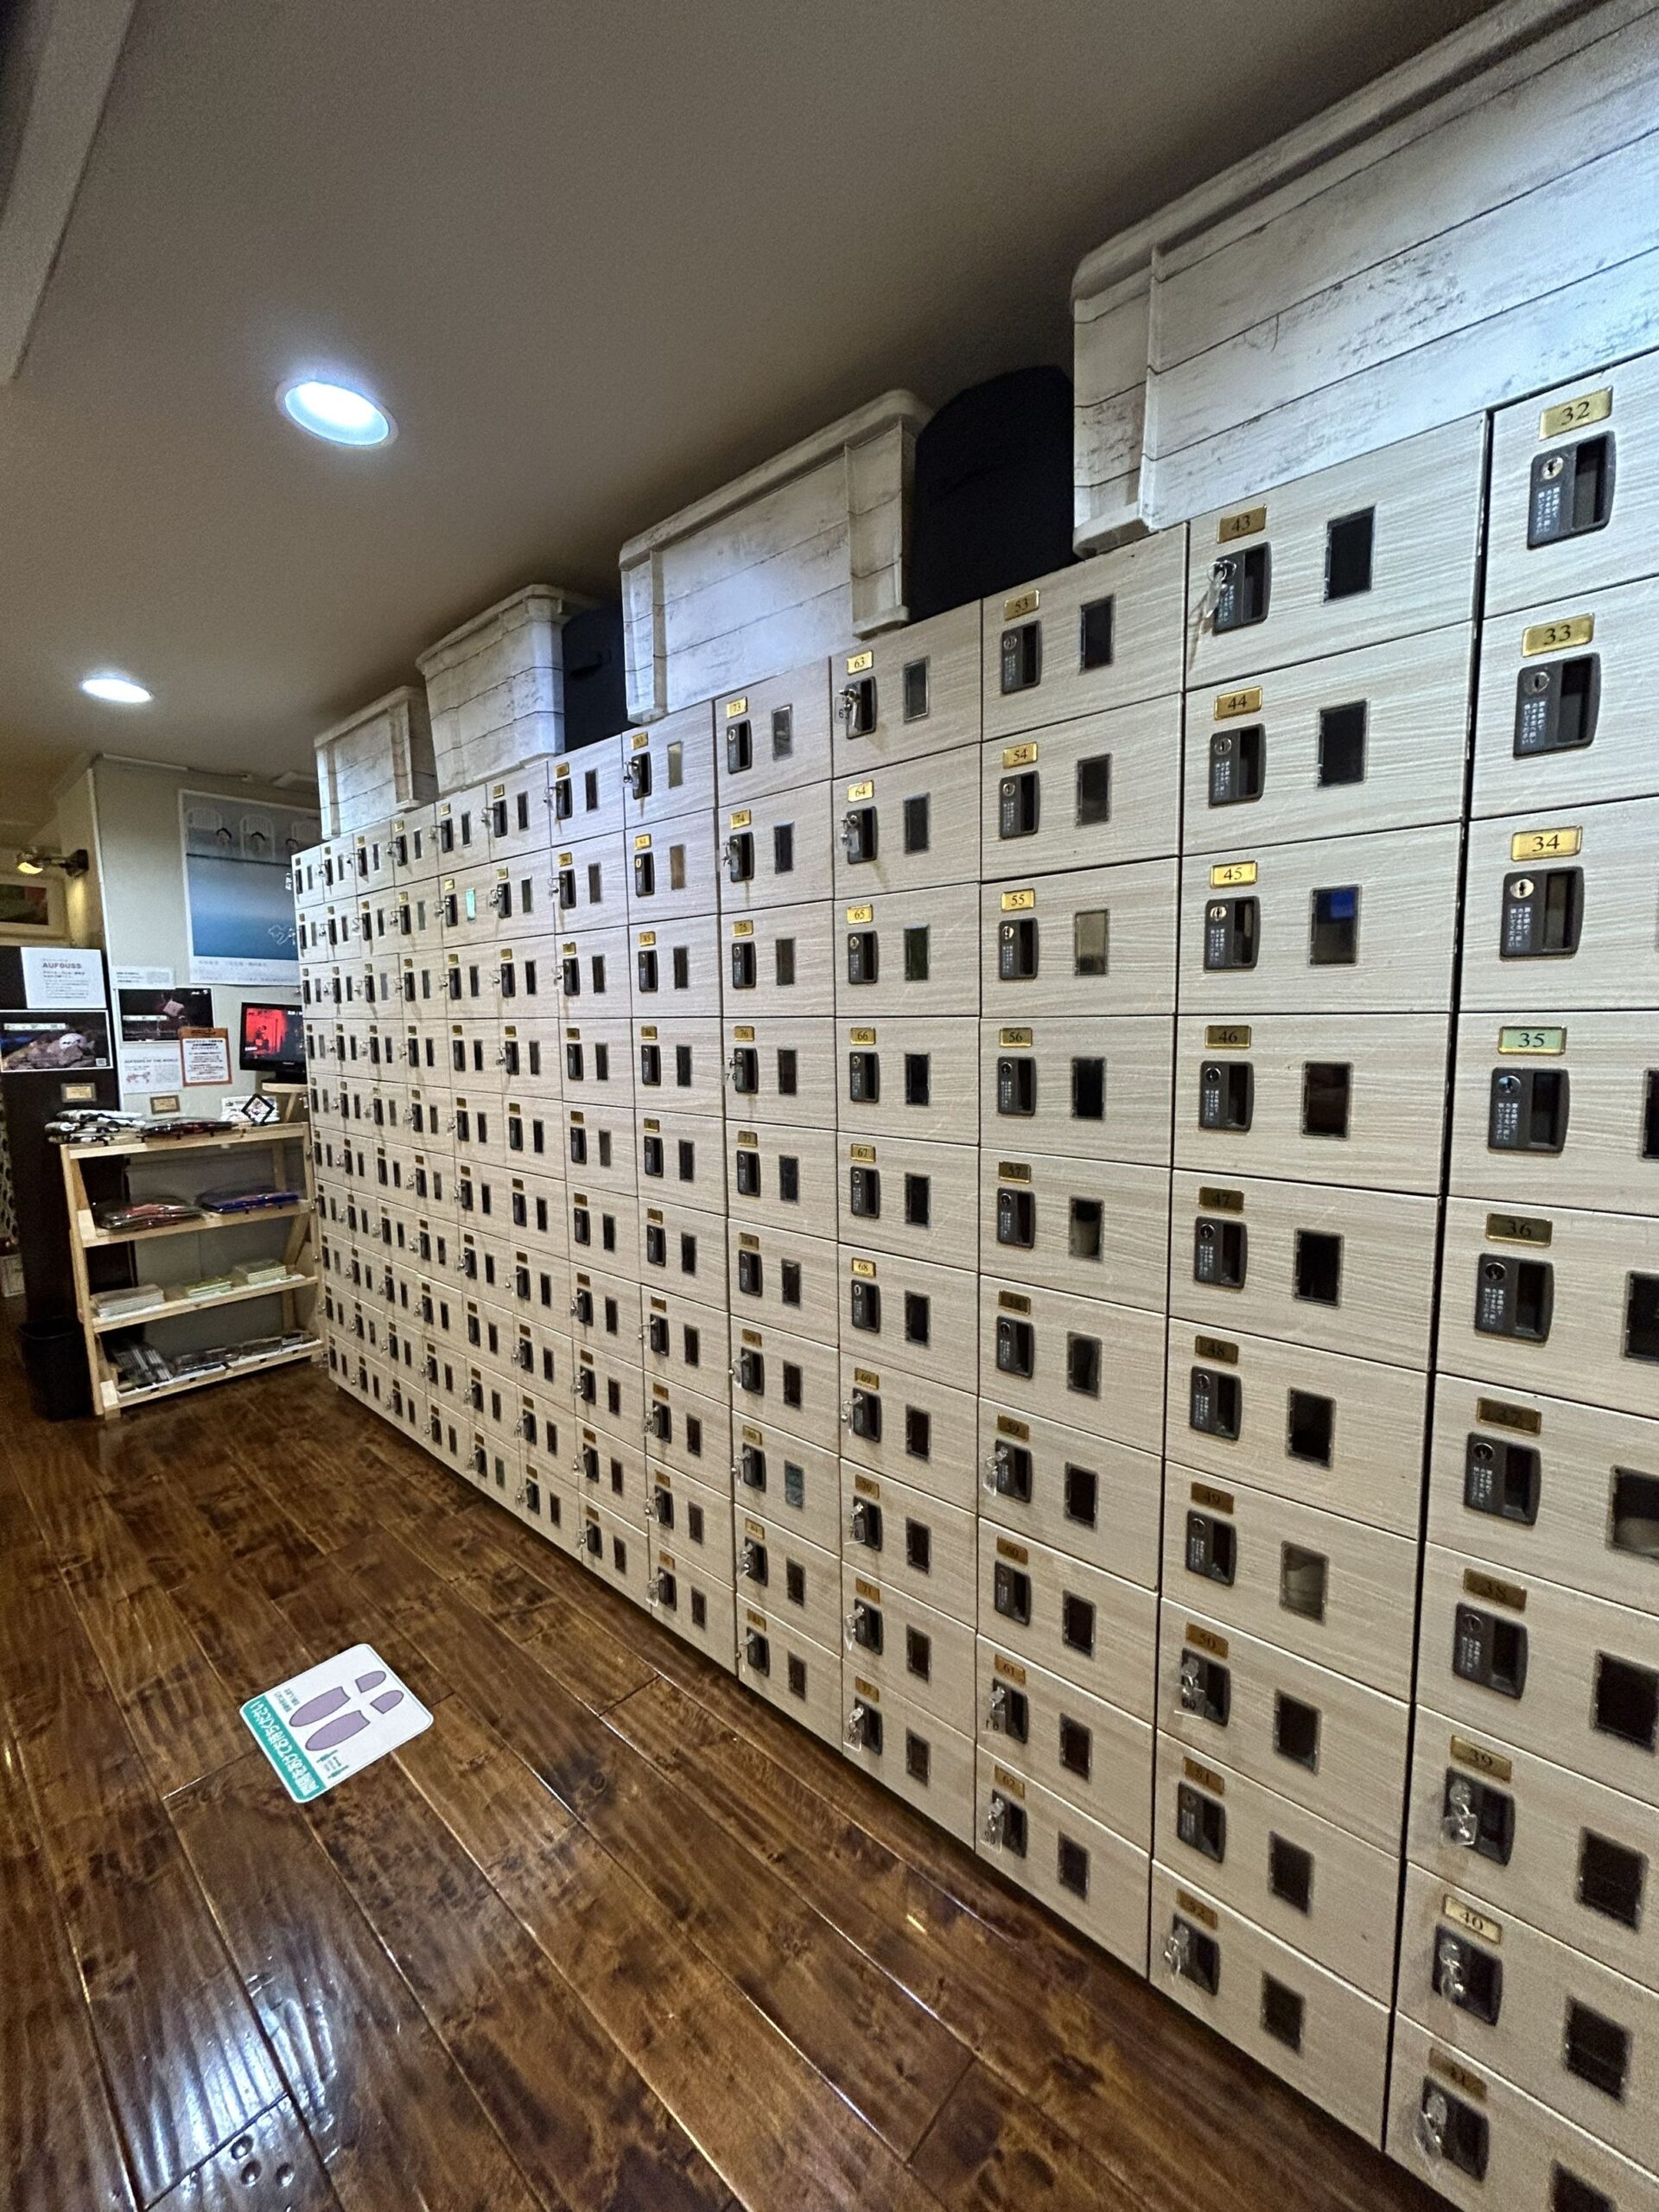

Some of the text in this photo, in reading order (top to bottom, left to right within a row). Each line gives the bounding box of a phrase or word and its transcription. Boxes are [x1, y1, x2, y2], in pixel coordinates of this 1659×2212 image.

[1560, 401, 1590, 426] 32
[1231, 515, 1250, 531] 43
[1015, 598, 1028, 613] 53
[1543, 624, 1572, 645] 33
[855, 657, 865, 669] 63
[733, 702, 741, 712] 73
[1227, 695, 1247, 709] 44
[1013, 748, 1027, 761] 54
[855, 786, 866, 797] 64
[1531, 834, 1560, 852] 34
[1224, 867, 1243, 880] 45
[1011, 894, 1025, 906] 55
[855, 909, 865, 919] 65
[857, 1032, 868, 1040] 66
[1009, 1032, 1022, 1043] 56
[1217, 1031, 1236, 1044] 46
[1518, 1033, 1546, 1048] 35
[857, 1148, 868, 1157] 67
[1505, 1220, 1531, 1236] 36
[858, 1263, 868, 1272] 68
[1470, 1748, 1493, 1766] 39
[1459, 1912, 1484, 1930] 40
